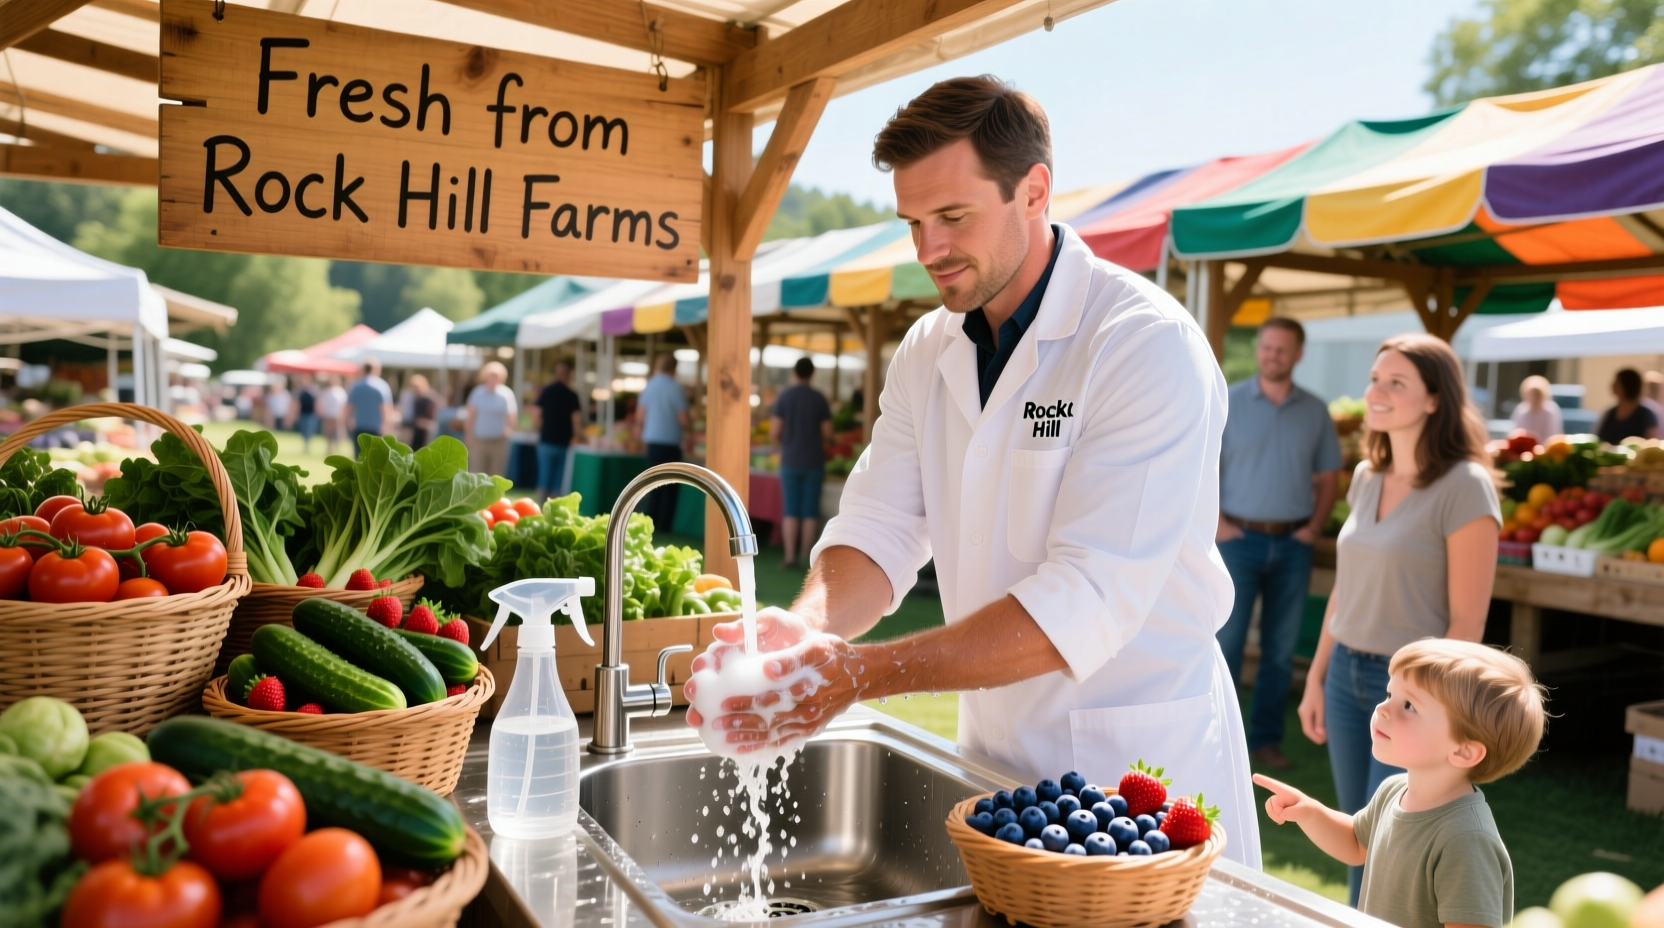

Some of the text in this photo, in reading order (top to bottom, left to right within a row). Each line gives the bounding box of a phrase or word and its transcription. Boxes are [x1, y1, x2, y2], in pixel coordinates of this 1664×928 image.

[257, 37, 629, 156] Fresh from
[203, 134, 680, 250] Rock Hill Farms
[1033, 419, 1061, 438] Hill
